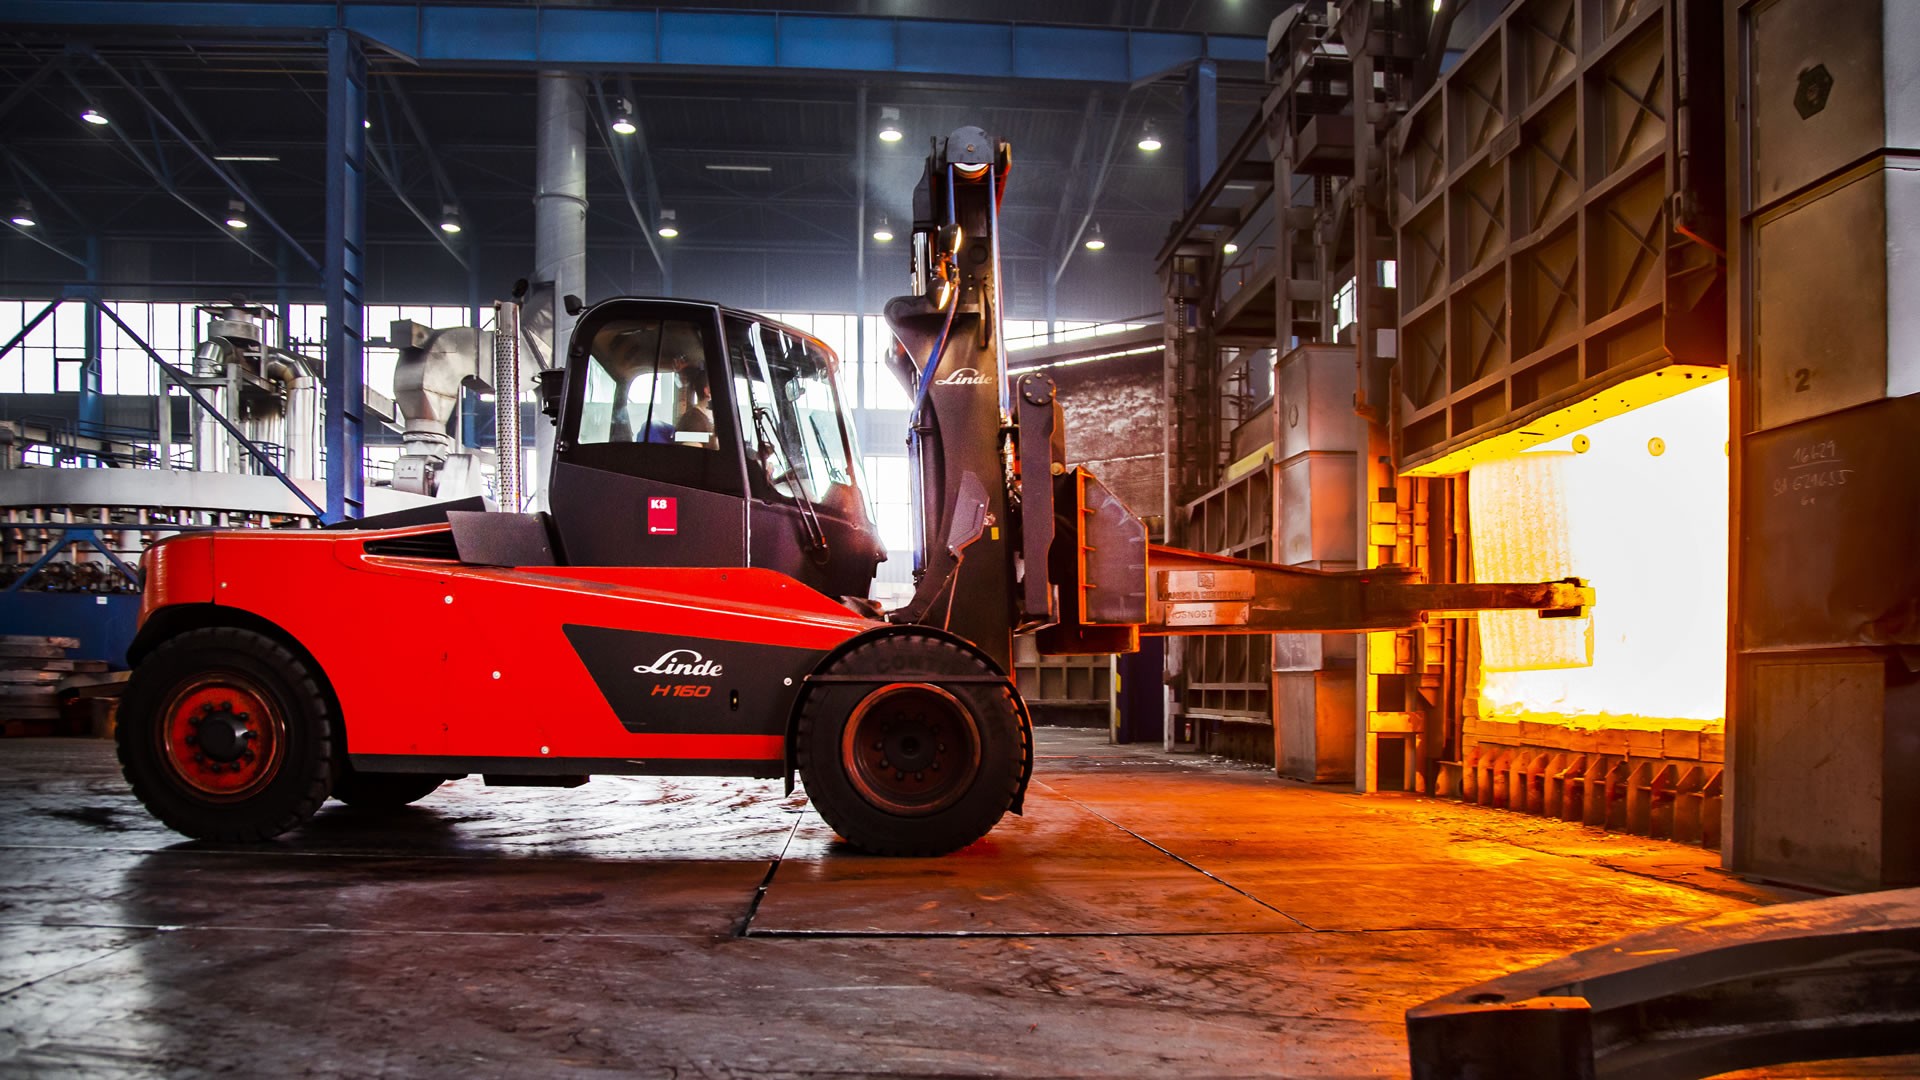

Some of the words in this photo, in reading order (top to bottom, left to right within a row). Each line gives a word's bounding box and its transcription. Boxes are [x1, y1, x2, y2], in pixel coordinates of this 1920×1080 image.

[935, 367, 993, 386] Linde
[1795, 368, 1810, 392] 2
[651, 499, 667, 509] K8
[633, 649, 723, 676] Linde
